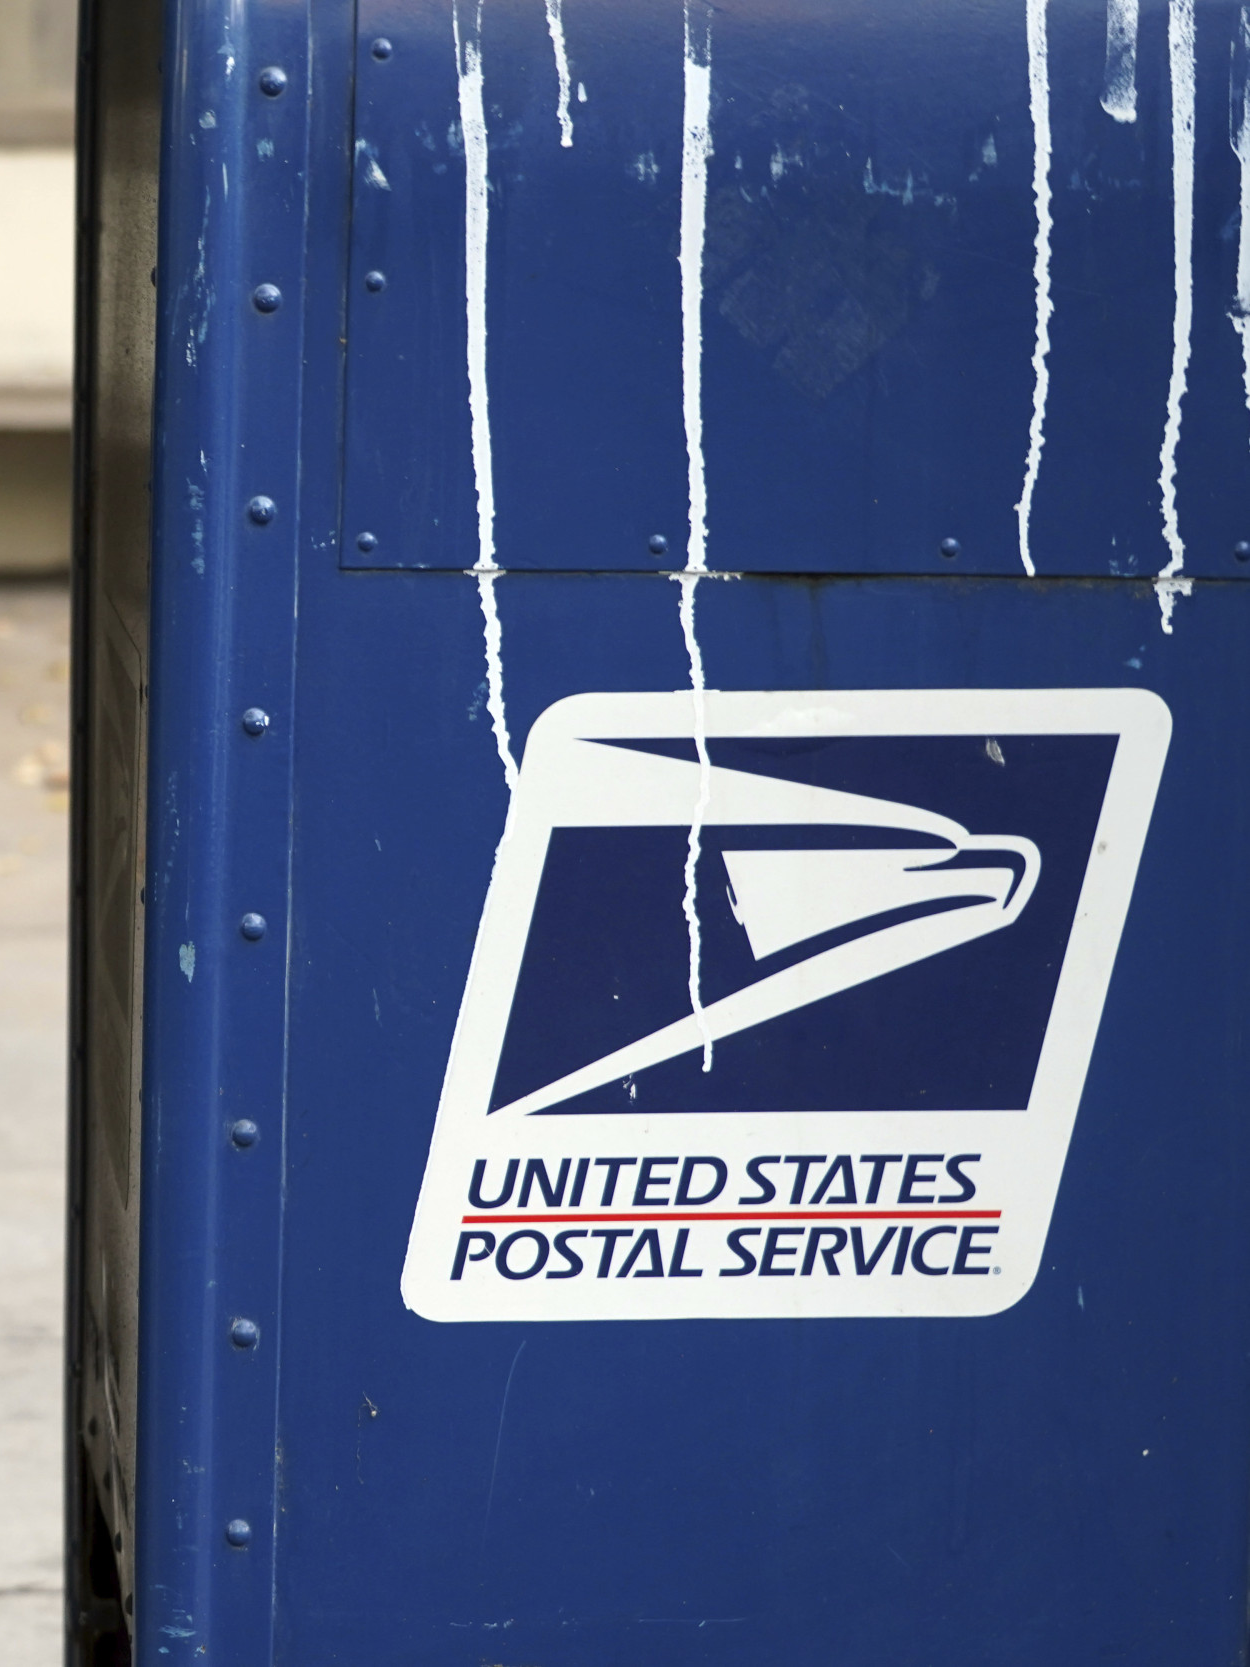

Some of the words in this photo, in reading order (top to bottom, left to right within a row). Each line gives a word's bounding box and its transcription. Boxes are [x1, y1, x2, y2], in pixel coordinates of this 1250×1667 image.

[467, 1156, 729, 1209] UNITED
[738, 1153, 982, 1205] STATES
[449, 1228, 704, 1281] POSTAL
